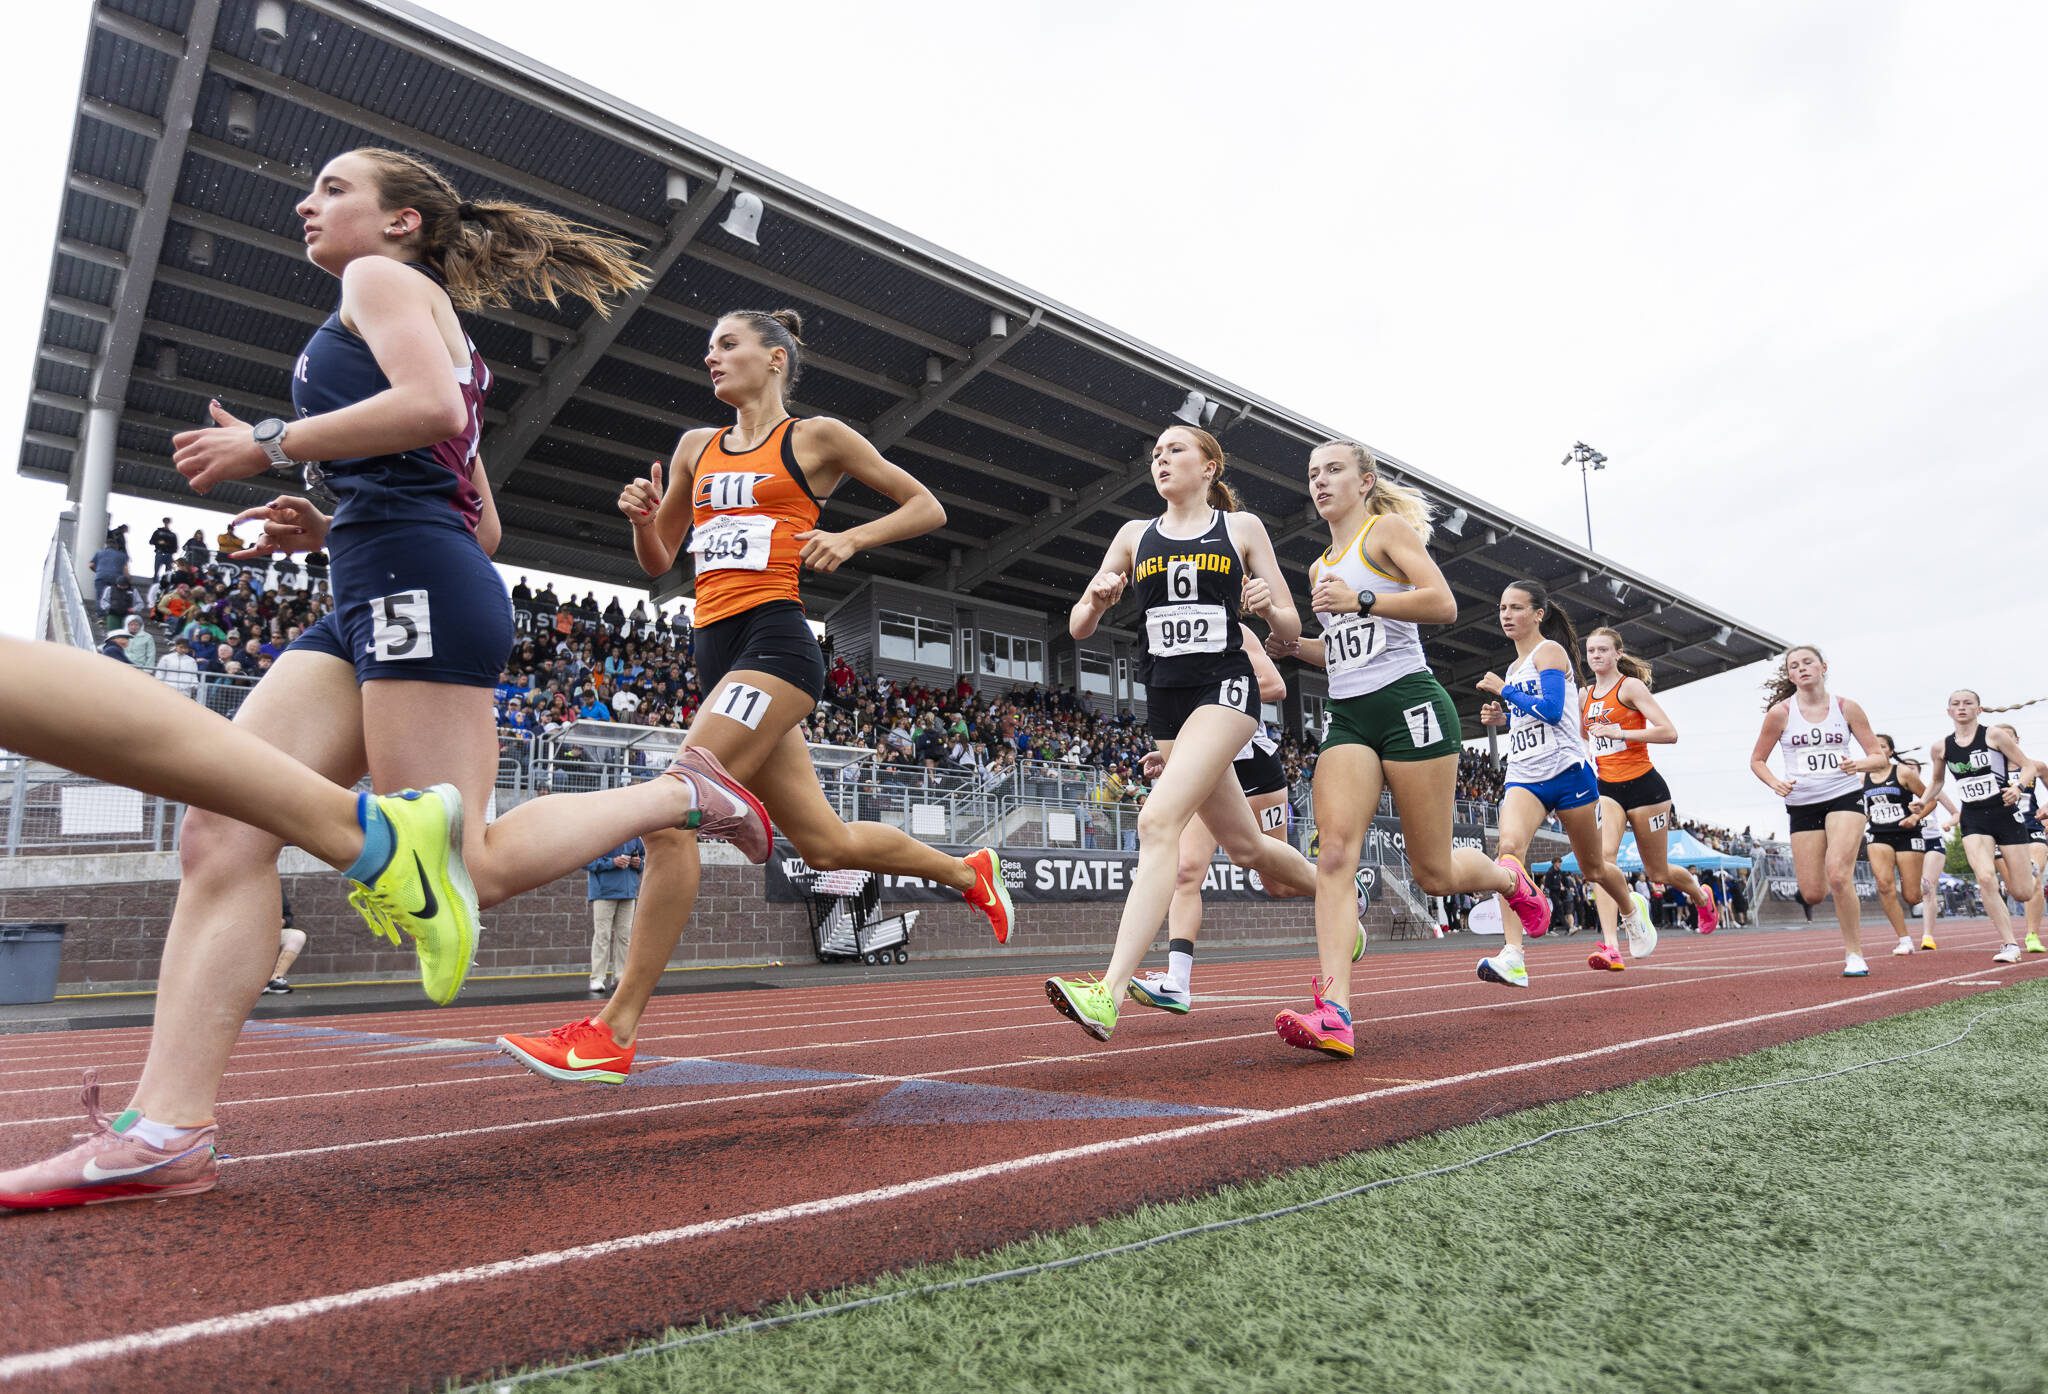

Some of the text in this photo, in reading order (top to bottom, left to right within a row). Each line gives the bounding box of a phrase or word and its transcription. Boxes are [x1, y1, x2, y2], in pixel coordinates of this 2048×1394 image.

[720, 474, 745, 505] 11
[1173, 563, 1191, 599] 6
[384, 594, 418, 655] 5
[1161, 619, 1209, 648] 992
[1324, 622, 1376, 665] 2157
[725, 685, 760, 721] 11
[1227, 678, 1242, 707] 6
[1410, 706, 1430, 744] 7
[1510, 723, 1545, 755] 2057
[1811, 728, 1822, 746] 9
[1807, 752, 1838, 771] 970
[1974, 753, 1989, 766] 10
[1961, 780, 1993, 799] 1597
[1265, 806, 1283, 828] 12
[1652, 814, 1665, 830] 15
[1873, 805, 1900, 819] 2170
[1000, 859, 1021, 870] Gesa
[1000, 869, 1027, 879] Credit
[1035, 859, 1093, 891] STATE
[1200, 864, 1244, 891] ATE
